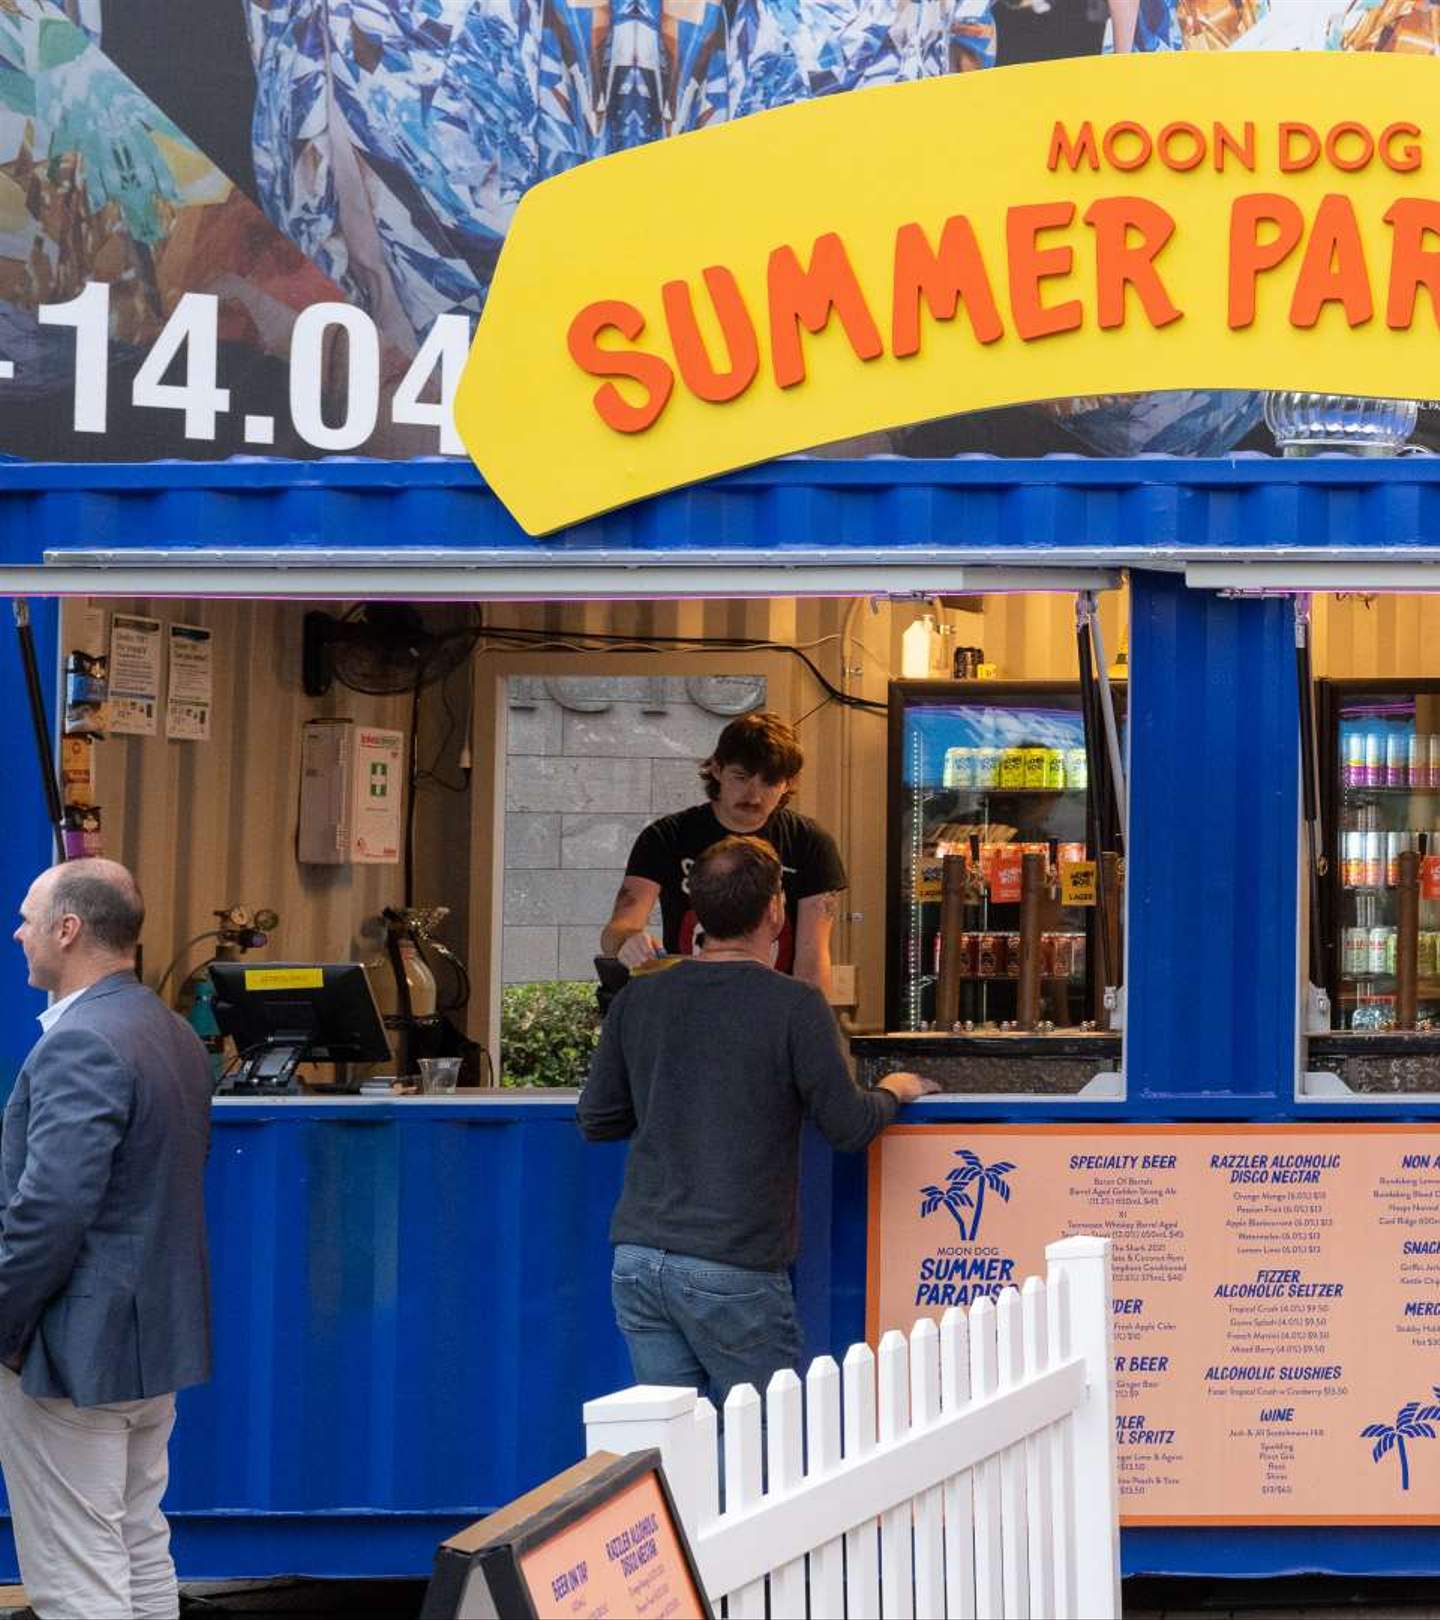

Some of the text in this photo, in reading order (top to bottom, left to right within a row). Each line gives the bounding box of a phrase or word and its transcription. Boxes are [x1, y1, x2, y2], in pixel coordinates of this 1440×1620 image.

[1047, 121, 1423, 172] MOON DOG
[566, 196, 1184, 434] SUMMER
[1069, 1155, 1177, 1169] SPECIALTY BEER
[1210, 1154, 1341, 1168] RAZZLER ALCOHOLIC
[1402, 1155, 1431, 1169] NON
[1230, 1170, 1320, 1184] DISCO NECTAR
[937, 1247, 1000, 1256] MOON DOG
[920, 1257, 1015, 1281] SUMMER
[1257, 1269, 1301, 1283] FIZZER
[915, 1283, 1020, 1307] PARADIS
[1214, 1284, 1344, 1298] ALCOHOLIC SELTZER
[1129, 1356, 1169, 1371] BEER
[1204, 1366, 1342, 1380] ALCOHOLIC SLUSHIES
[1260, 1408, 1295, 1422] WINE
[1129, 1430, 1175, 1444] SPRITZ
